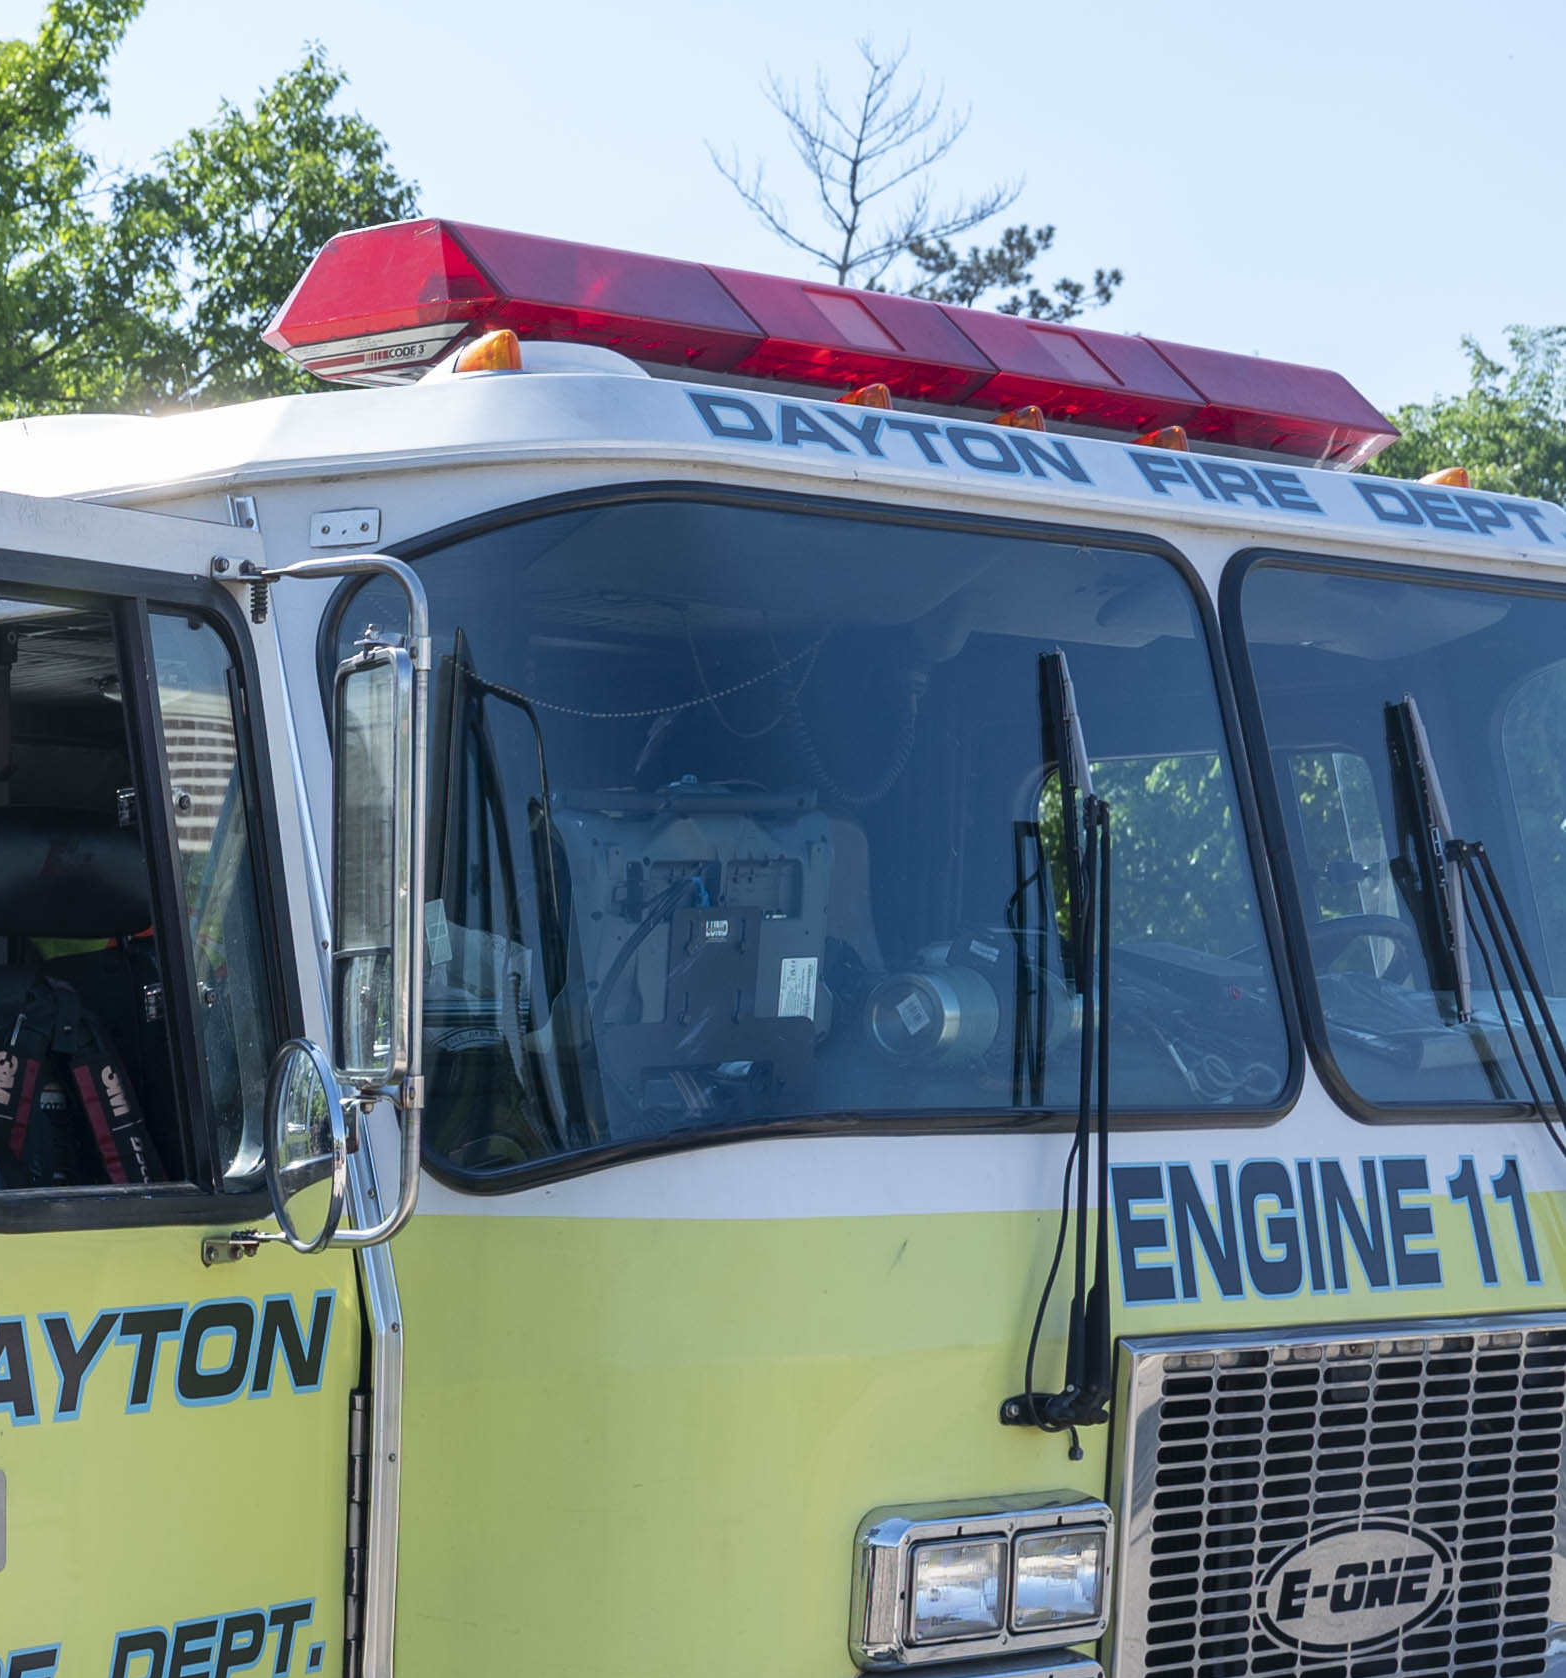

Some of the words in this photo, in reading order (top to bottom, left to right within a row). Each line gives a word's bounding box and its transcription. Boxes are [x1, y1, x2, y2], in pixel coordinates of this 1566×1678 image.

[389, 345, 416, 358] CODE
[418, 344, 425, 354] 3
[687, 390, 1094, 487] DAYTON
[1129, 448, 1327, 517] FIRE
[1347, 478, 1566, 545] DEPT
[1109, 1154, 1445, 1307] ENGINE
[1446, 1153, 1544, 1288] 11
[1277, 1555, 1435, 1621] E-ONE
